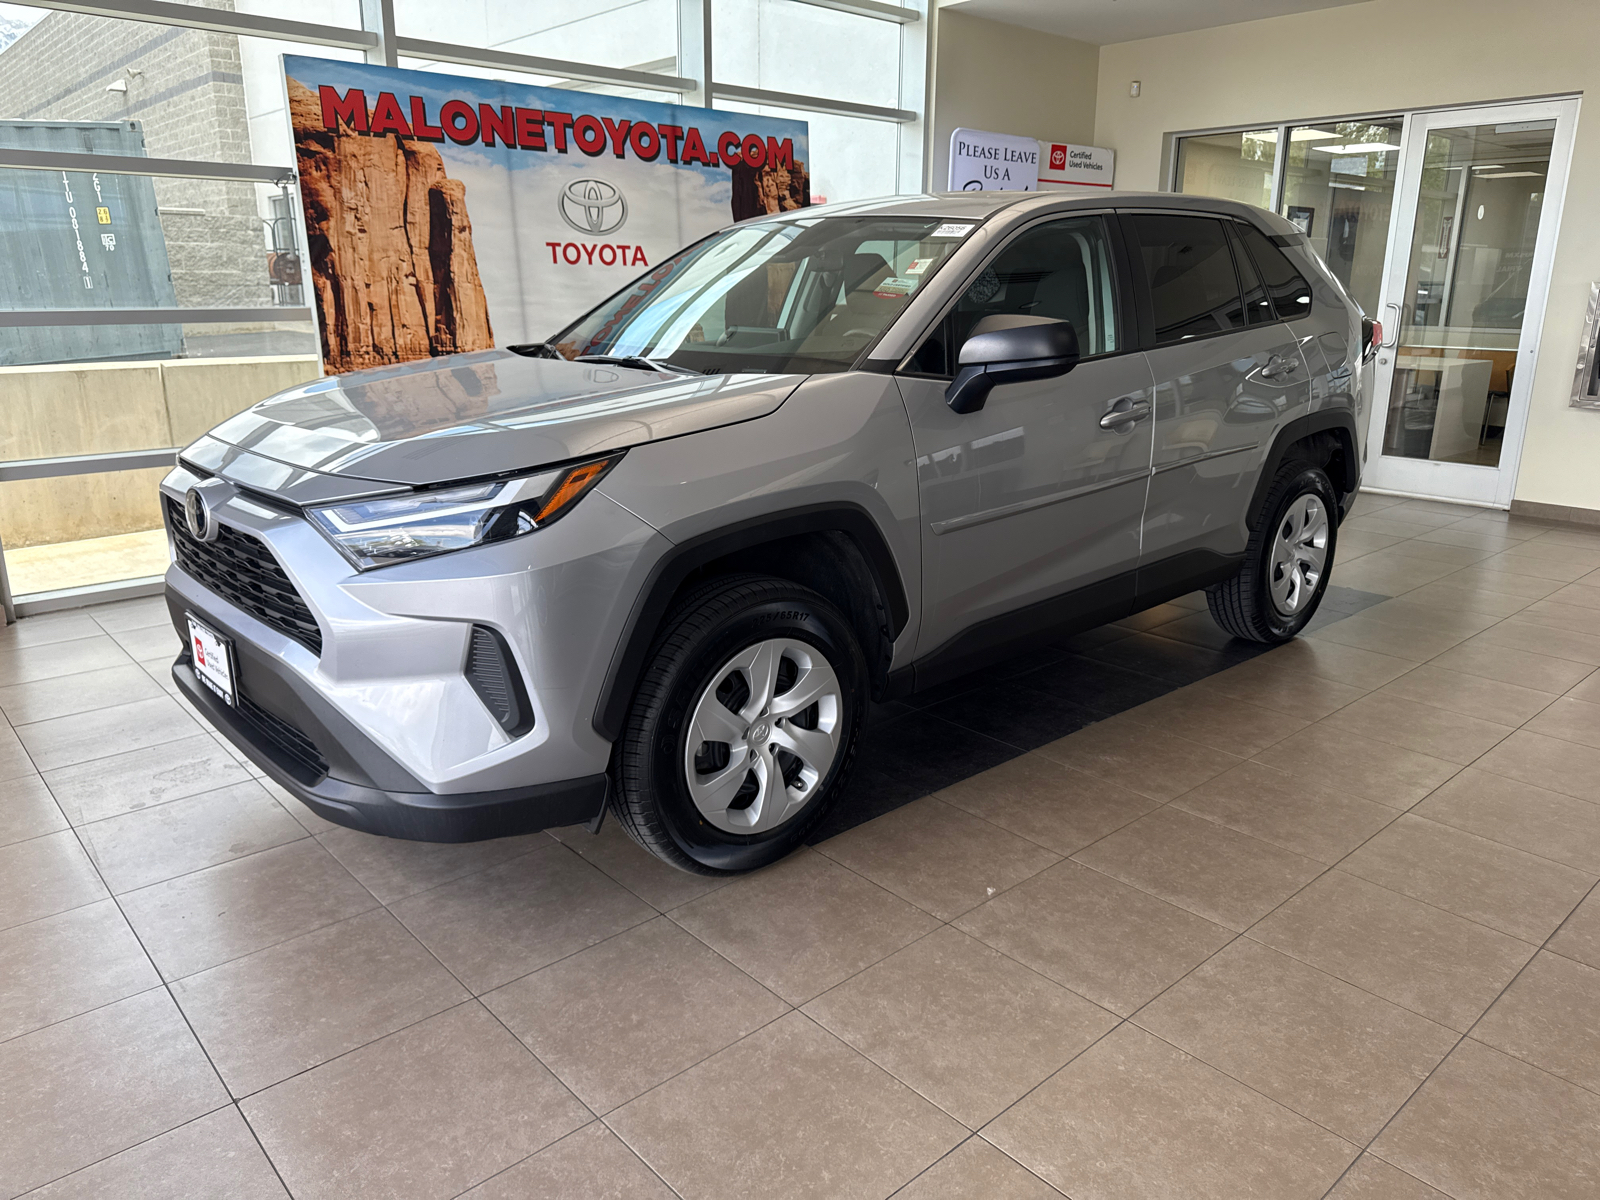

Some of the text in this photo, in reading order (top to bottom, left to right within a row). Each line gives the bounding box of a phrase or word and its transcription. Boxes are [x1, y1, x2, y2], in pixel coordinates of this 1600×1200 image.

[318, 84, 794, 172] MALONETOYOTA.COM
[958, 141, 1037, 165] PLEASE LEAVE
[1069, 150, 1092, 160] Certified
[1001, 167, 1011, 181] A
[1068, 160, 1103, 171] Used Vehicles
[545, 241, 649, 267] TOYOTA
